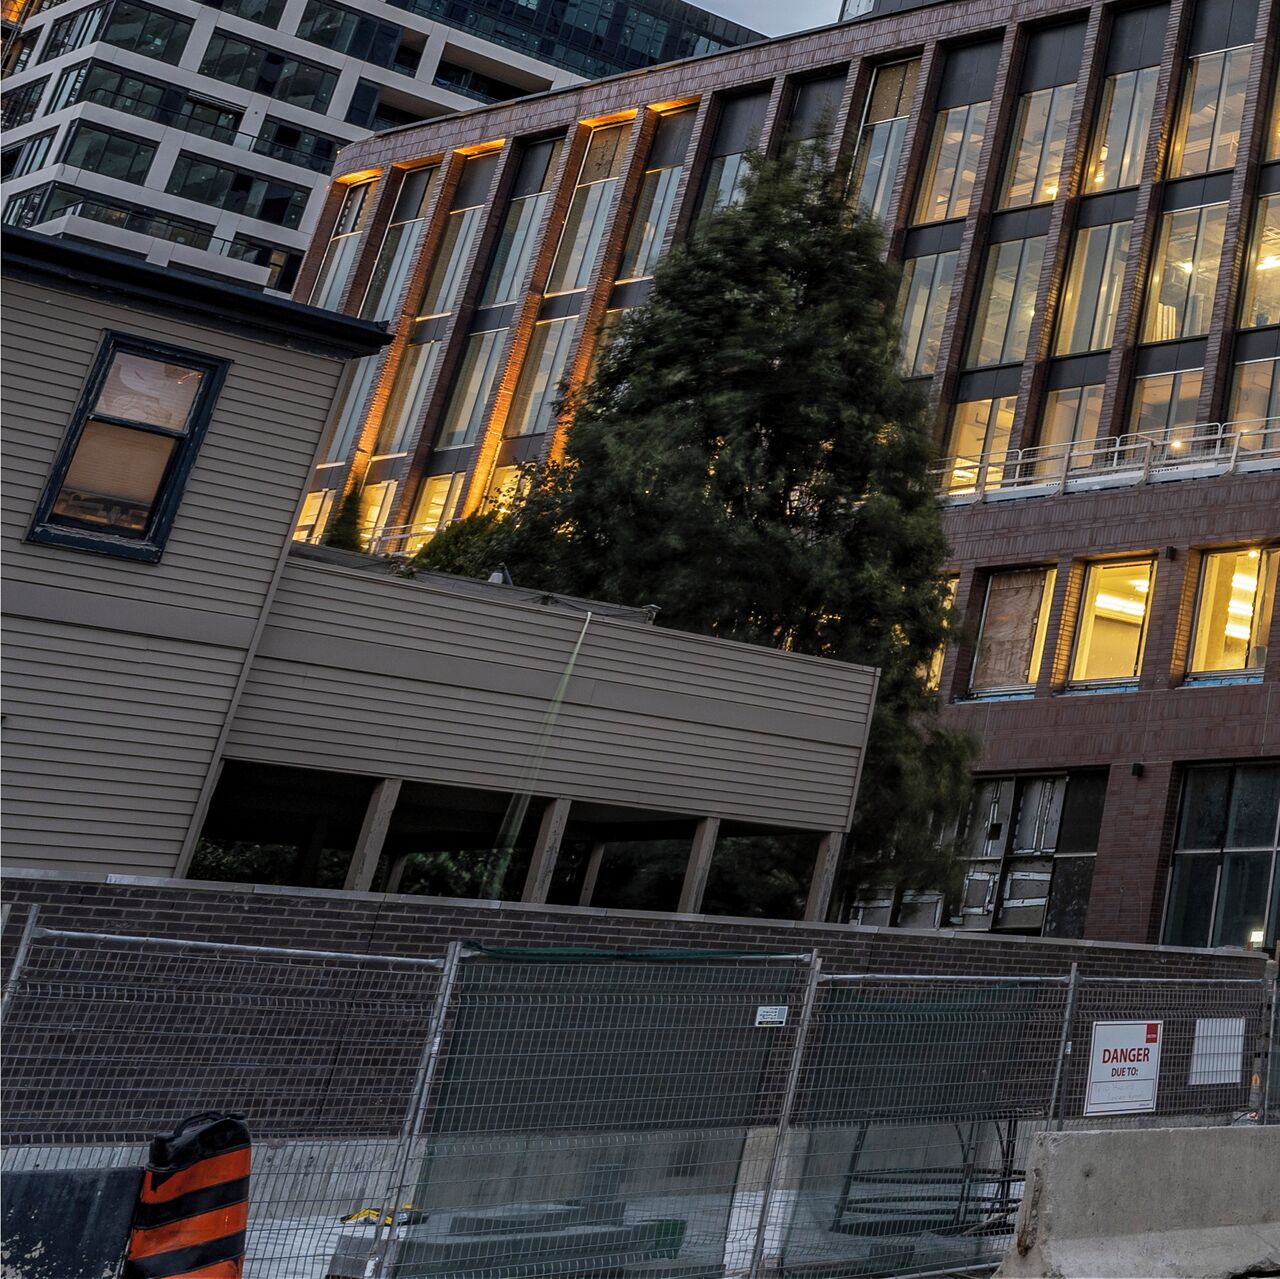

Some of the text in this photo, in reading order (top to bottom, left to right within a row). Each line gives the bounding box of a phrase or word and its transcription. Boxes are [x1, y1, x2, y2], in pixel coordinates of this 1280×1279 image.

[1102, 1047, 1150, 1063] DANGER
[1111, 1067, 1138, 1077] DUE TO:
